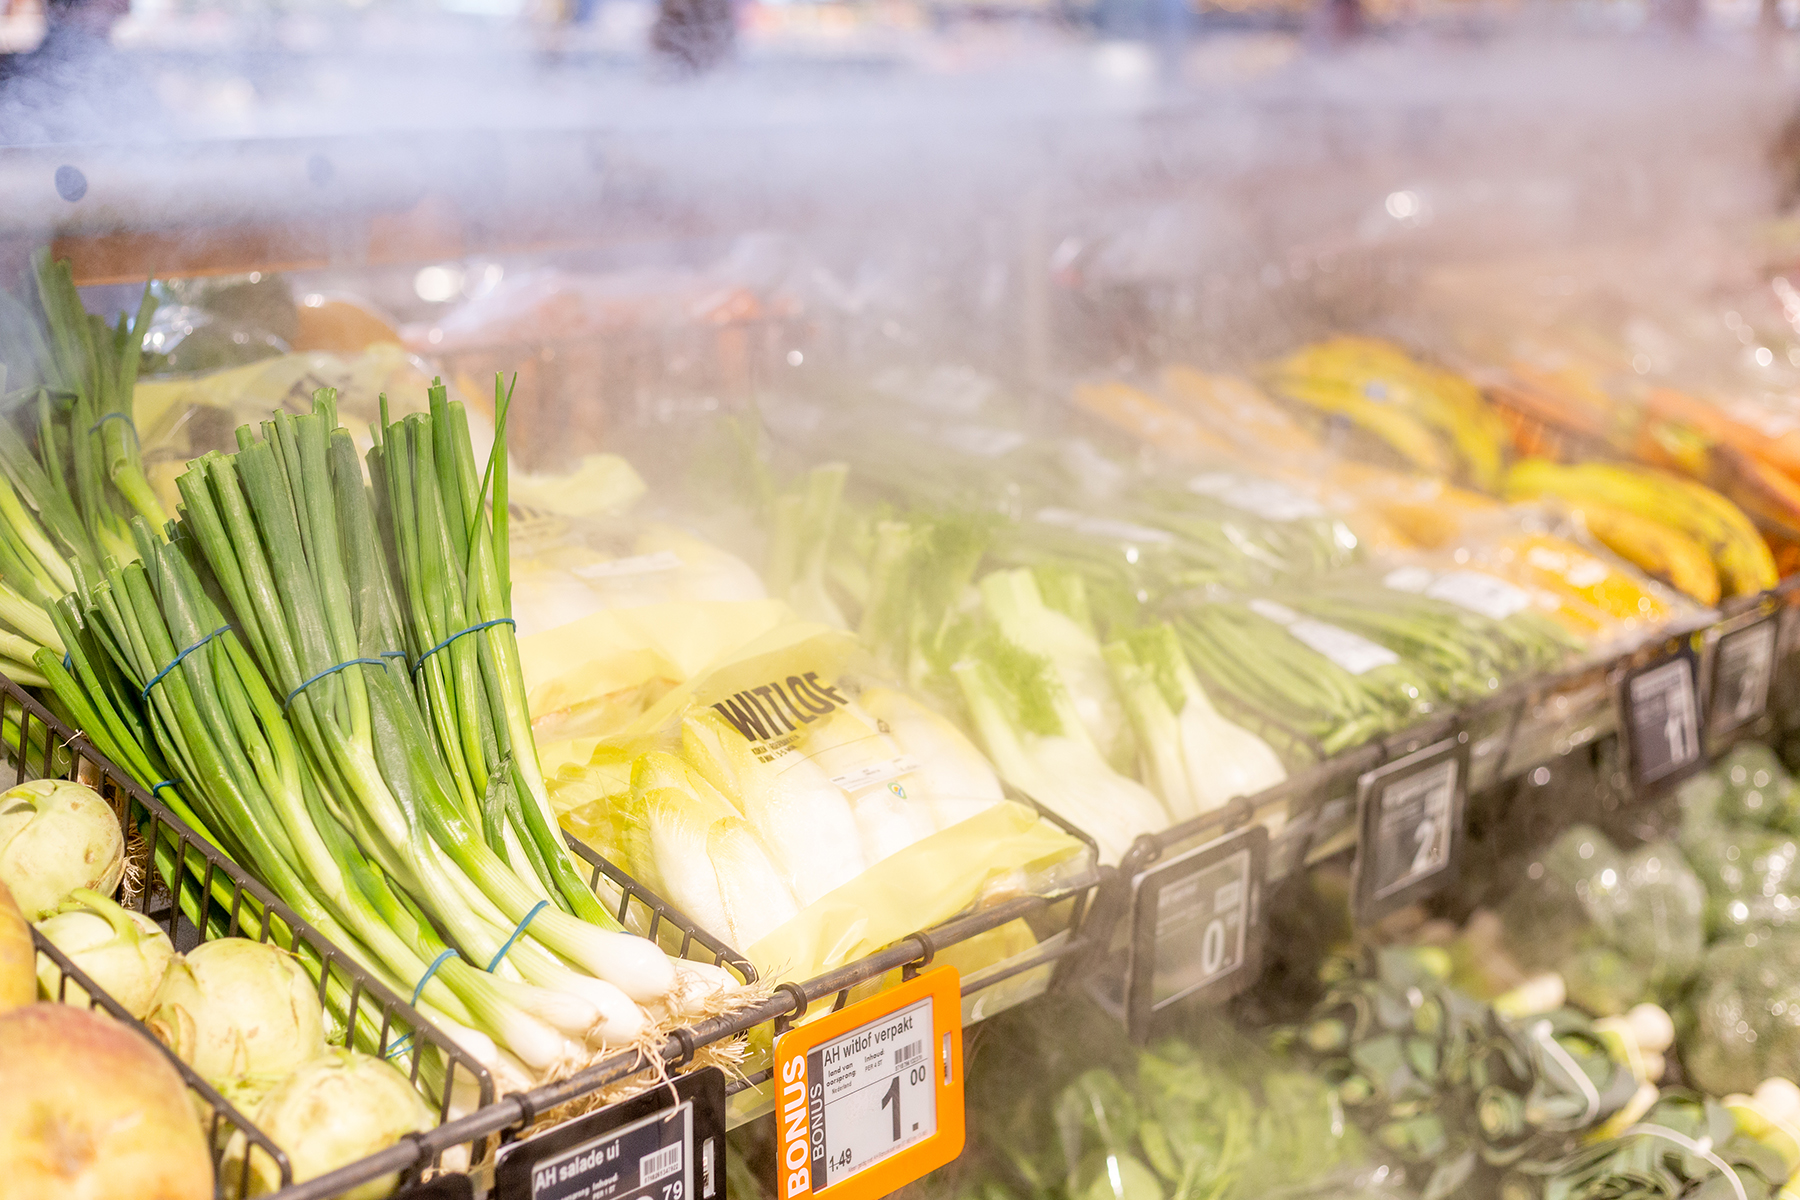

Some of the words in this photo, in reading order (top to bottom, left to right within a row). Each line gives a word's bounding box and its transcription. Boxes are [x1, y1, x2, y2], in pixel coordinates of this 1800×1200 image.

[709, 671, 849, 742] WITLOF
[824, 1045, 840, 1067] AH
[842, 1031, 872, 1058] witlof
[874, 1016, 913, 1044] verpakt
[828, 1066, 841, 1078] land
[842, 1062, 853, 1071] van
[865, 1063, 874, 1072] PER
[910, 1065, 926, 1086] 00
[782, 1055, 810, 1199] BONUS
[810, 1083, 825, 1162] BONUS
[534, 1166, 557, 1193] AH
[559, 1149, 604, 1182] salade
[606, 1139, 620, 1162] ui
[829, 1148, 852, 1172] 1.49
[662, 1180, 683, 1200] 79
